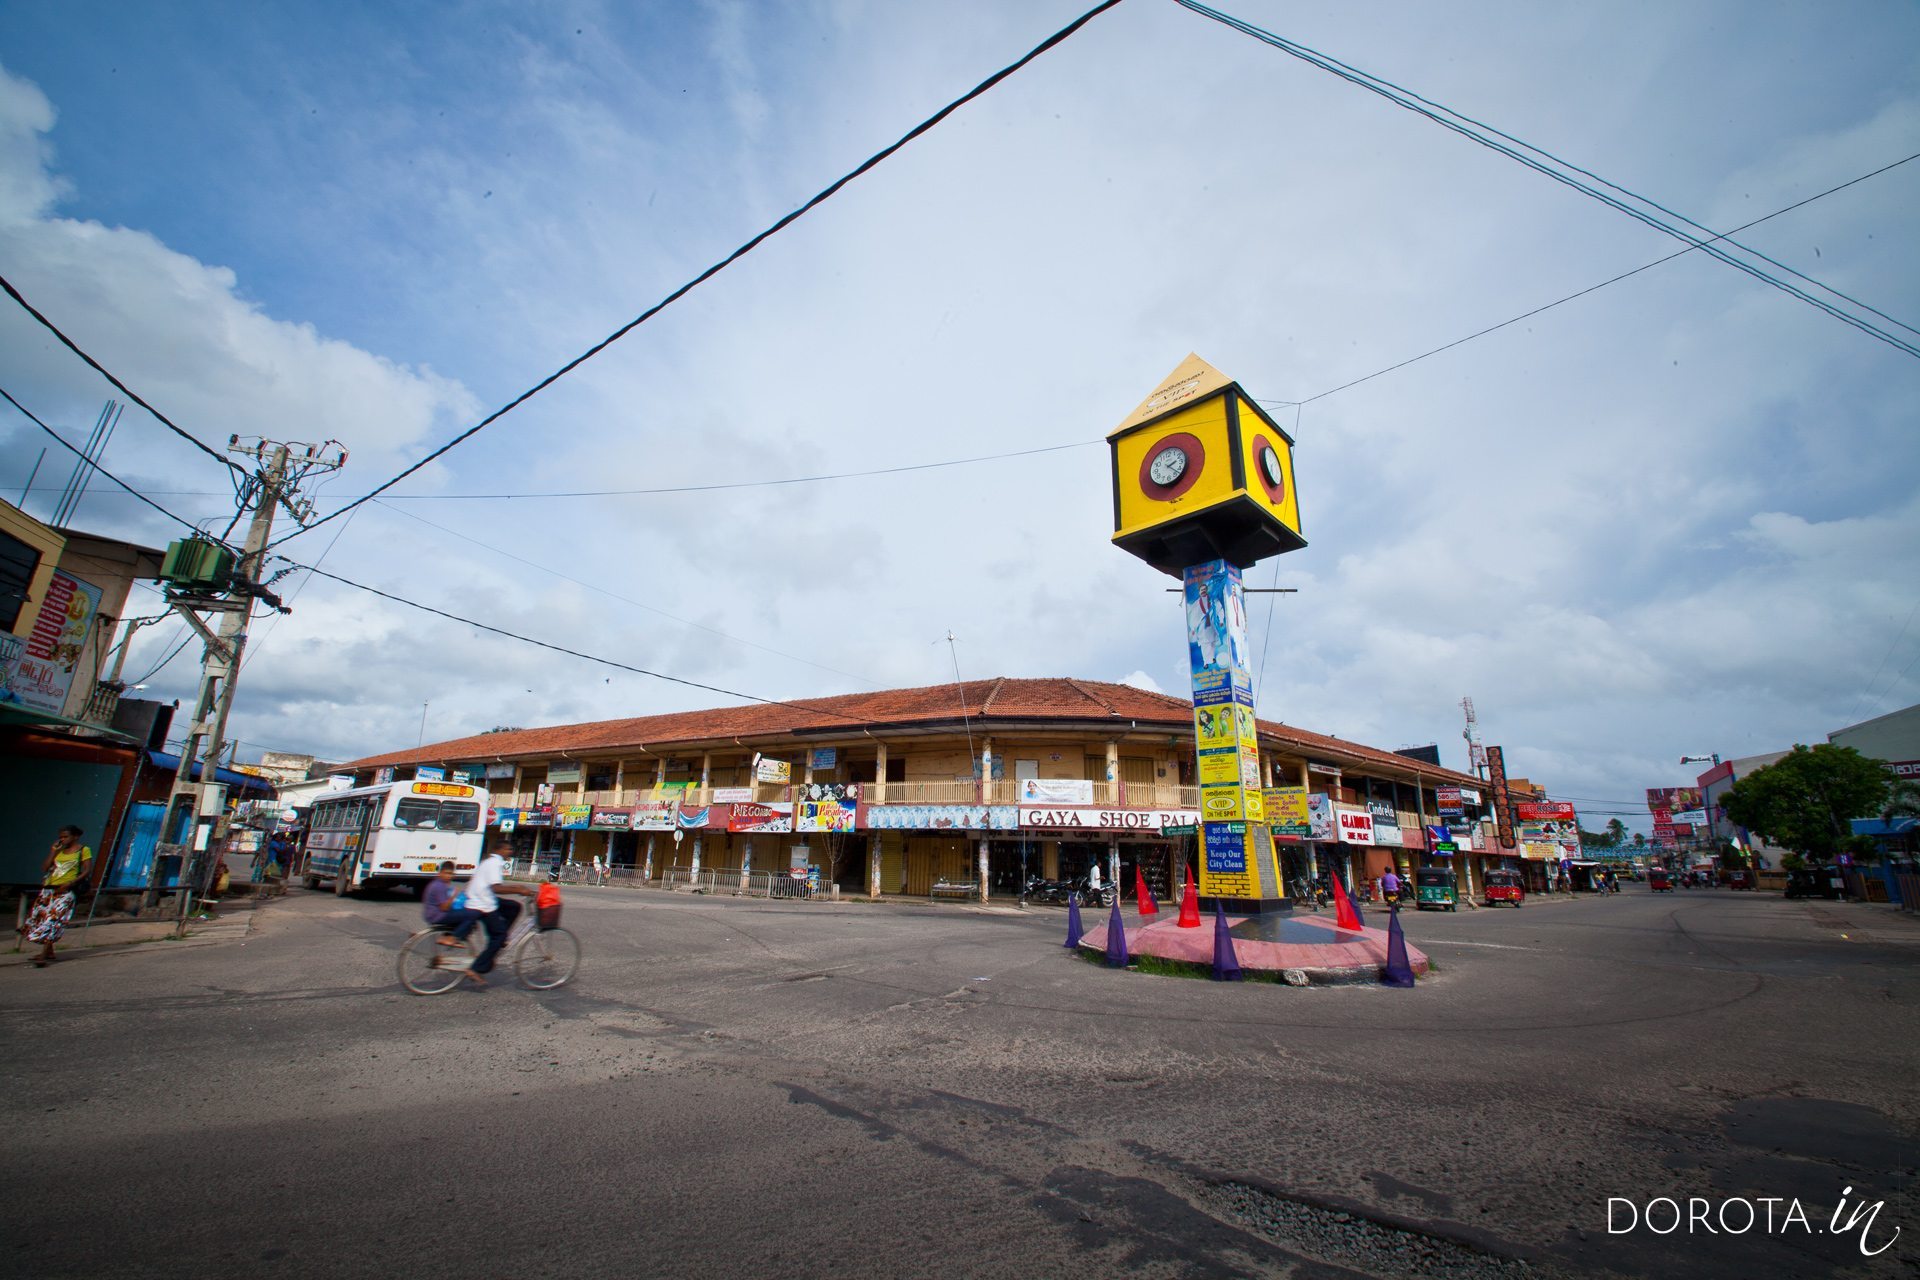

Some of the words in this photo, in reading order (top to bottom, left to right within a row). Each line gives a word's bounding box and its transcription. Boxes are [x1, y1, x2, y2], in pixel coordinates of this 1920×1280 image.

[0, 637, 22, 661] TIK
[1214, 800, 1227, 808] VIP
[1029, 811, 1082, 826] GAYA
[1100, 812, 1151, 828] SHOE
[1341, 814, 1372, 830] GLAMOUR
[1210, 850, 1227, 860] Keep
[1228, 850, 1241, 858] Our
[1209, 859, 1223, 870] City
[1224, 859, 1243, 868] Clean
